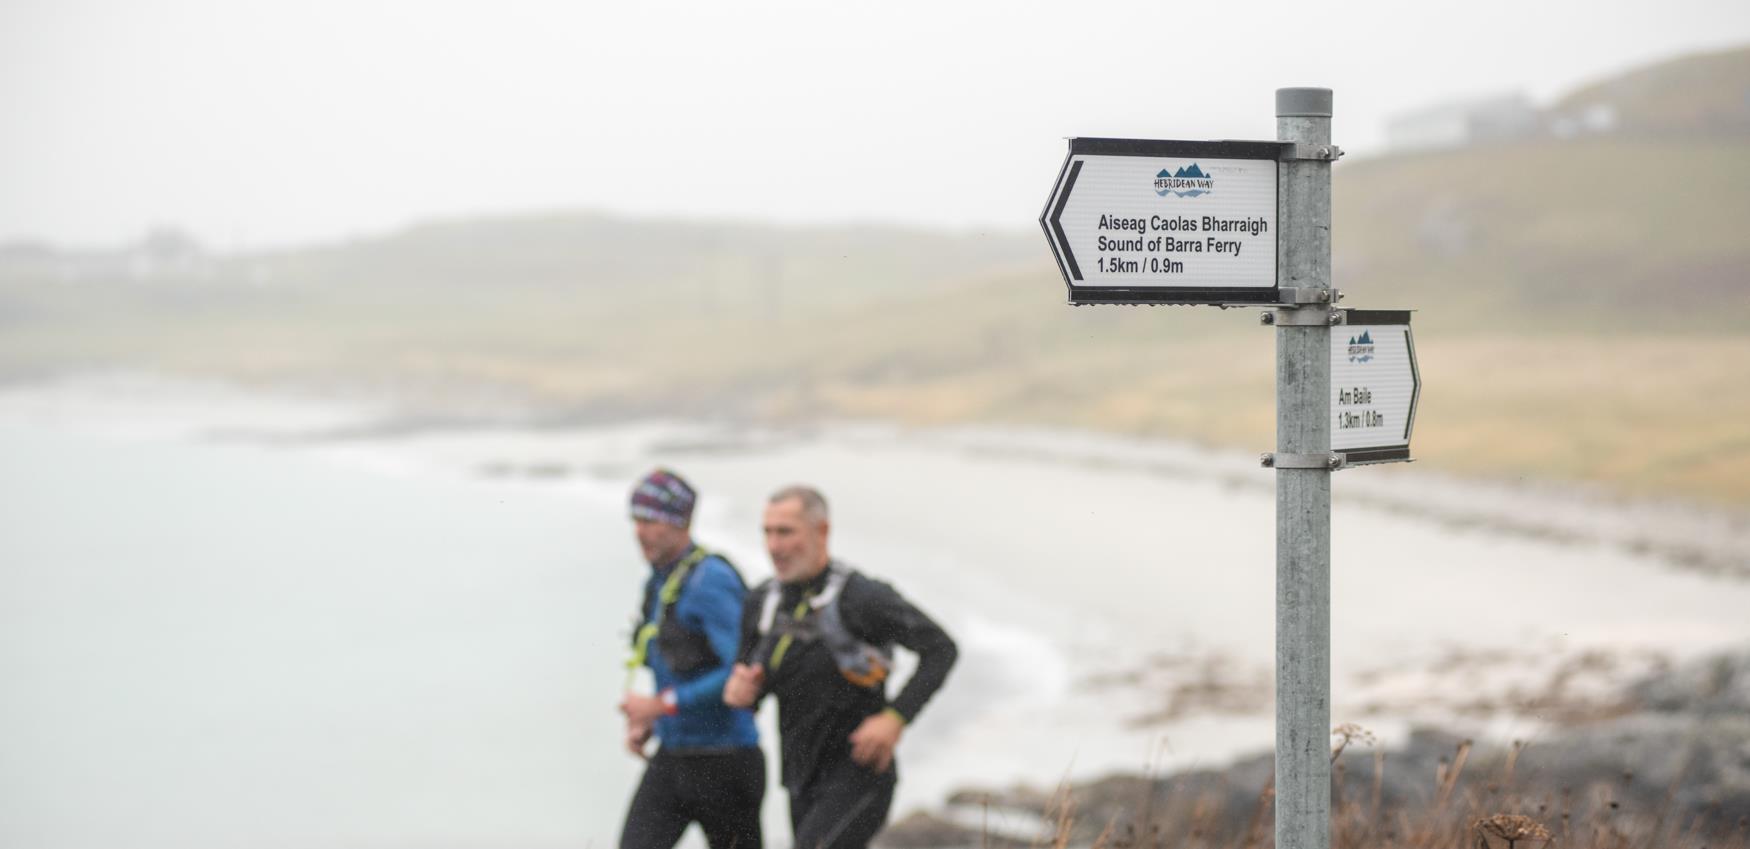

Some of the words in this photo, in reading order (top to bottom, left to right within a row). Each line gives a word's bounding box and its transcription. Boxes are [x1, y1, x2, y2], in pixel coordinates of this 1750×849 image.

[1153, 179, 1196, 190] HEBRIDEAN
[1197, 179, 1214, 190] WAY
[1098, 214, 1146, 234] Aiseag
[1151, 215, 1198, 232] Caolas
[1202, 215, 1268, 236] Bharraigh
[1098, 235, 1143, 252] Sound
[1148, 236, 1162, 252] of
[1166, 236, 1202, 252] Barra
[1207, 237, 1242, 256] Ferry
[1098, 257, 1138, 273] 1.5km
[1142, 257, 1147, 274] /
[1151, 257, 1184, 273] 0.9m
[1339, 388, 1351, 405] Am
[1353, 387, 1371, 404] Baile
[1339, 411, 1360, 429] 1.3km
[1366, 410, 1383, 428] 0.8m
